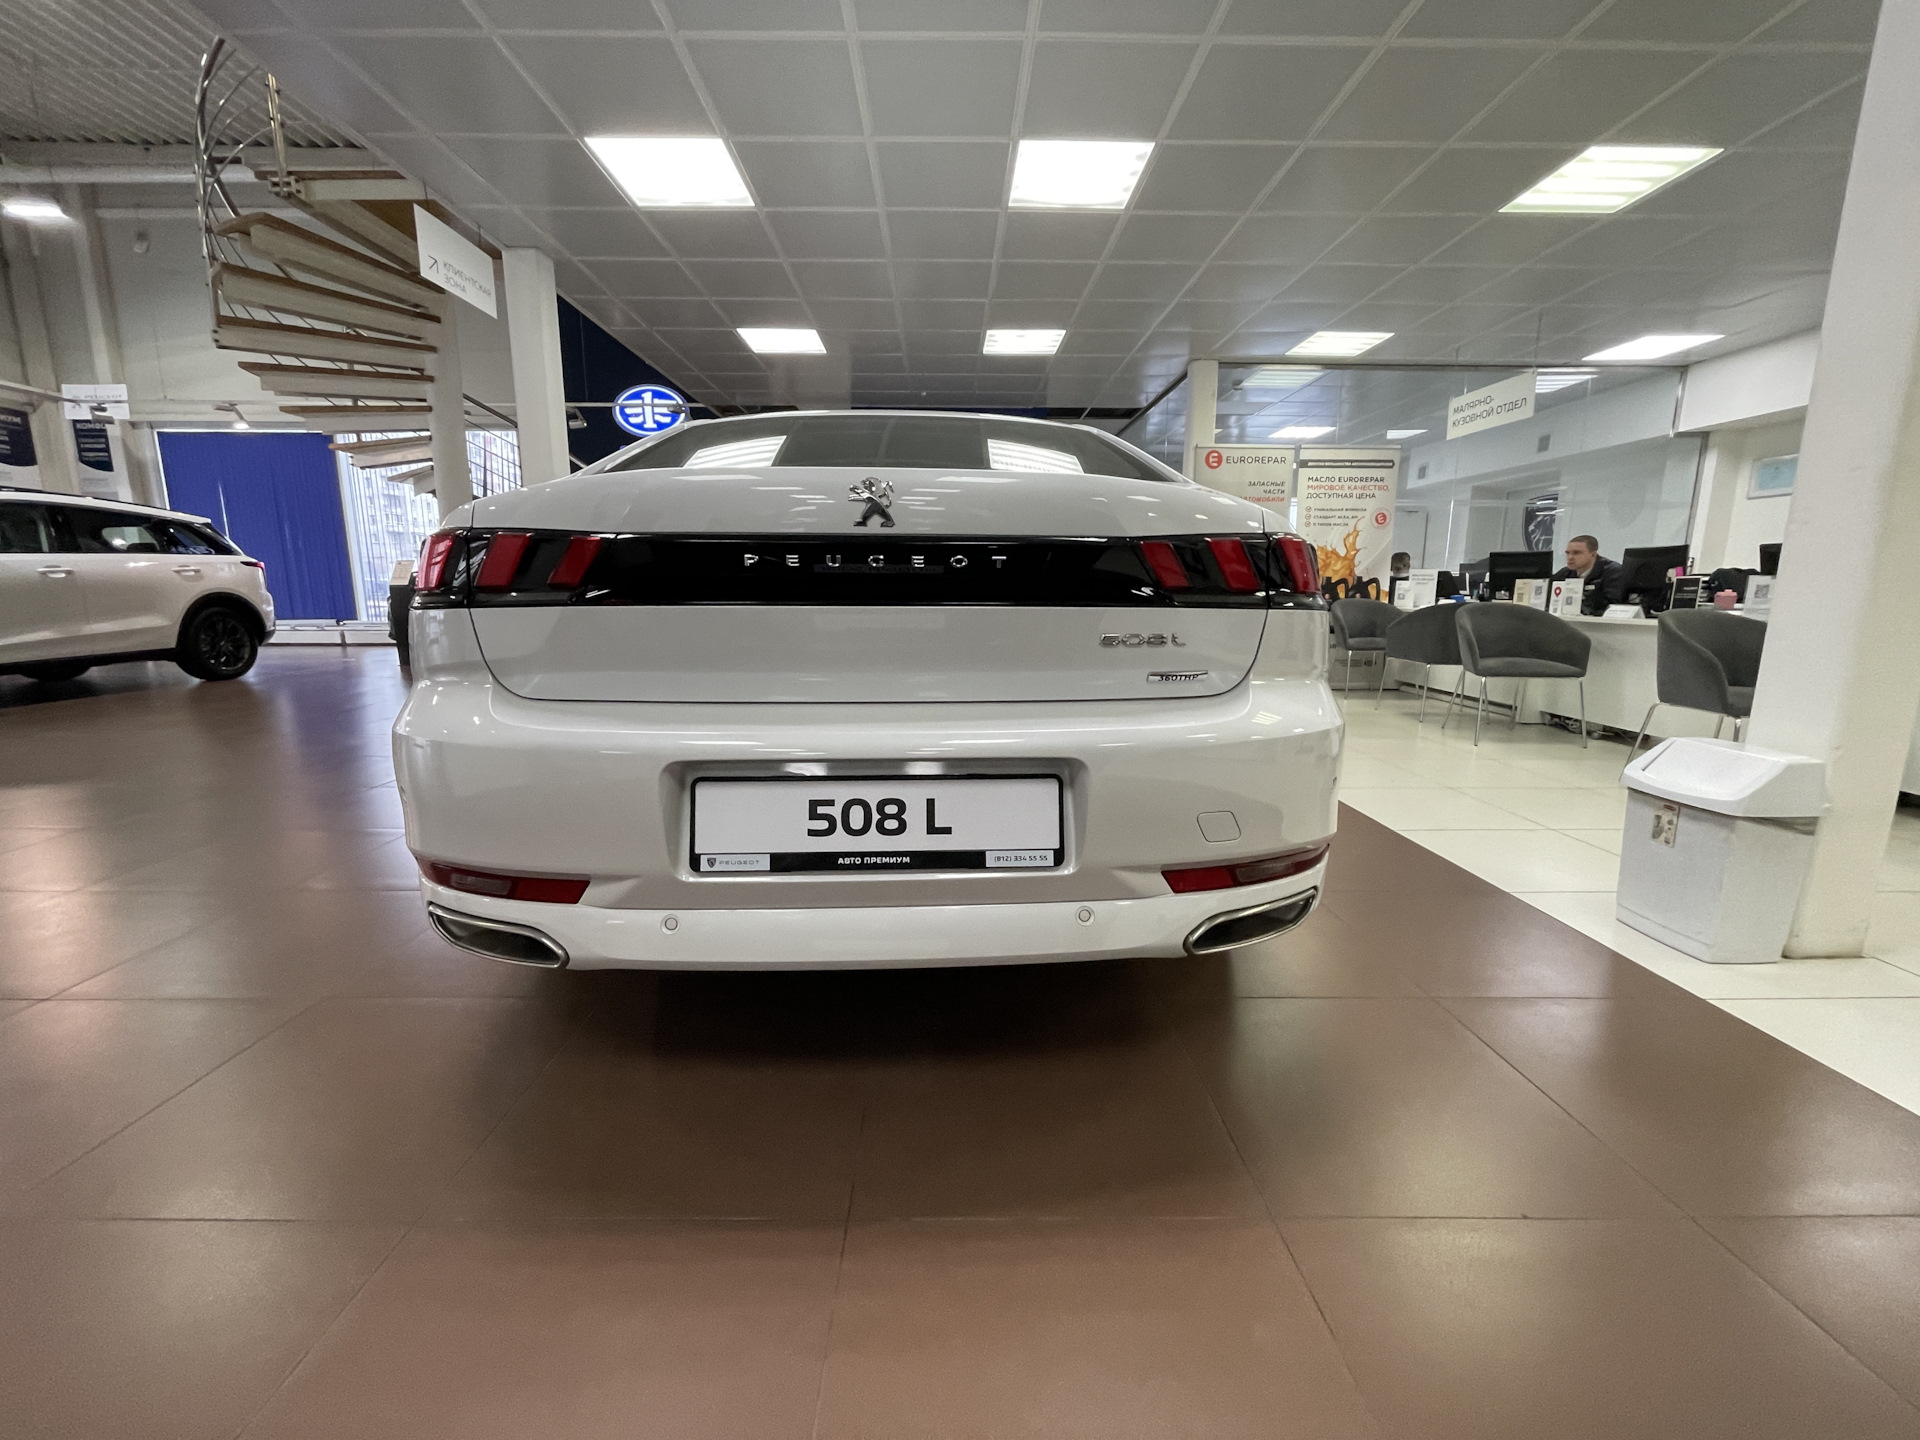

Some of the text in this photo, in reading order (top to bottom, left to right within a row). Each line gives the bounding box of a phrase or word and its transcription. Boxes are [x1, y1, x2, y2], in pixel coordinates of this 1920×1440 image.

[444, 273, 467, 293] ЗОНА
[1453, 395, 1495, 415] МАЛЯРНО-
[1452, 397, 1527, 428] КУЗОВНОЙ ОТДЕЛ
[1226, 456, 1287, 464] EUROREPAR
[1347, 484, 1390, 492] КАЧЕСТВО,
[1355, 492, 1376, 500] ЦЕНА
[744, 554, 1007, 568] PEUGEOT
[1158, 674, 1199, 682] 360THP
[807, 797, 953, 838] 508 L
[837, 856, 911, 865] АВТО ПРЕМИУМ
[994, 855, 1012, 863] (812)
